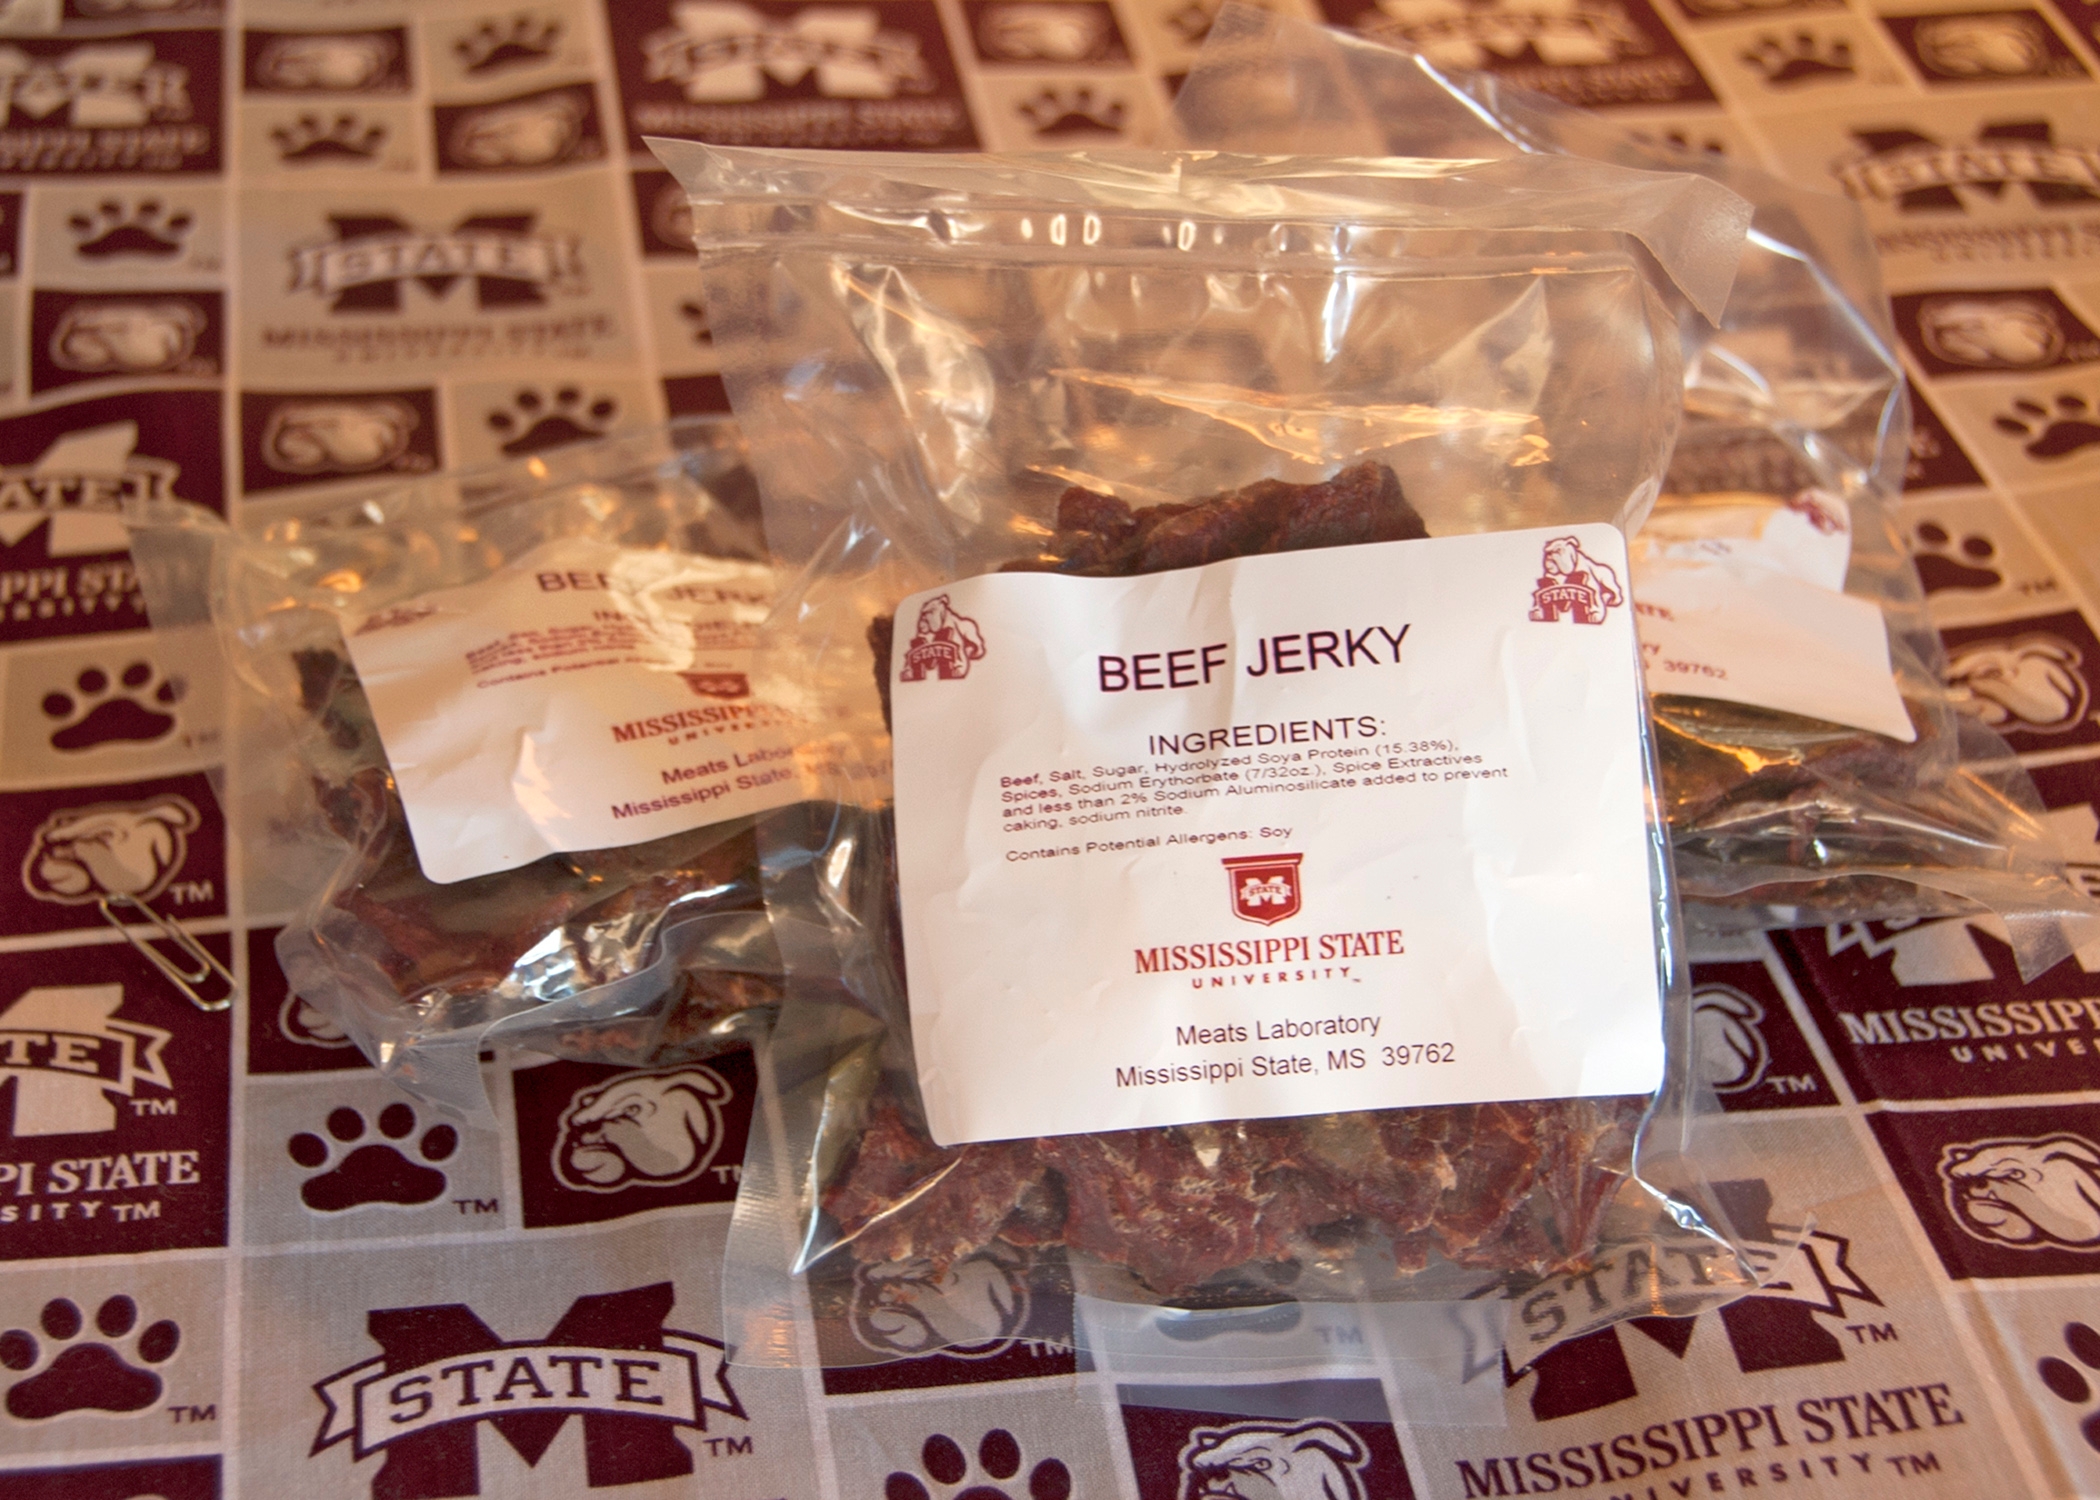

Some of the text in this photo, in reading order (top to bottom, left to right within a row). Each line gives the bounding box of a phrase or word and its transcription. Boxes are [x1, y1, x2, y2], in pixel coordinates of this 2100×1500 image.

[1541, 588, 1589, 605] STATE
[912, 646, 953, 664] STATE
[1099, 623, 1411, 693] BEEF JERKY
[1663, 658, 1729, 681] 39762
[1149, 715, 1387, 756] INGREDIENTS:
[660, 757, 729, 786] Meats
[1000, 772, 1044, 789] Beef,
[1049, 769, 1087, 783] Salt,
[1092, 763, 1149, 779] Sugar,
[1155, 754, 1251, 774] Hydrolyzed
[1257, 751, 1302, 766] Soya
[1307, 746, 1370, 761] Protein
[1001, 787, 1063, 804] Spices,
[1068, 779, 1134, 796] Sodium
[1139, 770, 1240, 790] Erythorbate
[1332, 760, 1382, 776] Spice
[1387, 753, 1483, 770] Extractives
[611, 781, 731, 819] Mississippi
[1002, 767, 1508, 818] and less than 2% Sodium Aluminosilicate added to prevent
[1002, 804, 1187, 833] caking, sodium nitrite.
[1005, 826, 1294, 863] Contains Potential Allergens: Soy
[168, 879, 215, 905] TM
[1134, 929, 1405, 974] MISSISSIPPI STATE
[1192, 966, 1353, 990] UNIVERSITY
[1176, 1016, 1381, 1046] Meats Laboratory
[1949, 1037, 2100, 1063] UNIVE
[1116, 1042, 1456, 1088] Mississippi State, MS 39762
[1765, 1074, 1817, 1093] TM
[128, 1098, 178, 1117] TM
[47, 1150, 200, 1194] STATE
[452, 1198, 499, 1215] TM
[1845, 1321, 1898, 1345] TM
[389, 1354, 665, 1424] STATE
[167, 1403, 217, 1424] TM
[702, 1436, 754, 1457] TM
[1454, 1382, 1965, 1499] MISSISSIPPI STATE
[1886, 1451, 1942, 1478] TM
